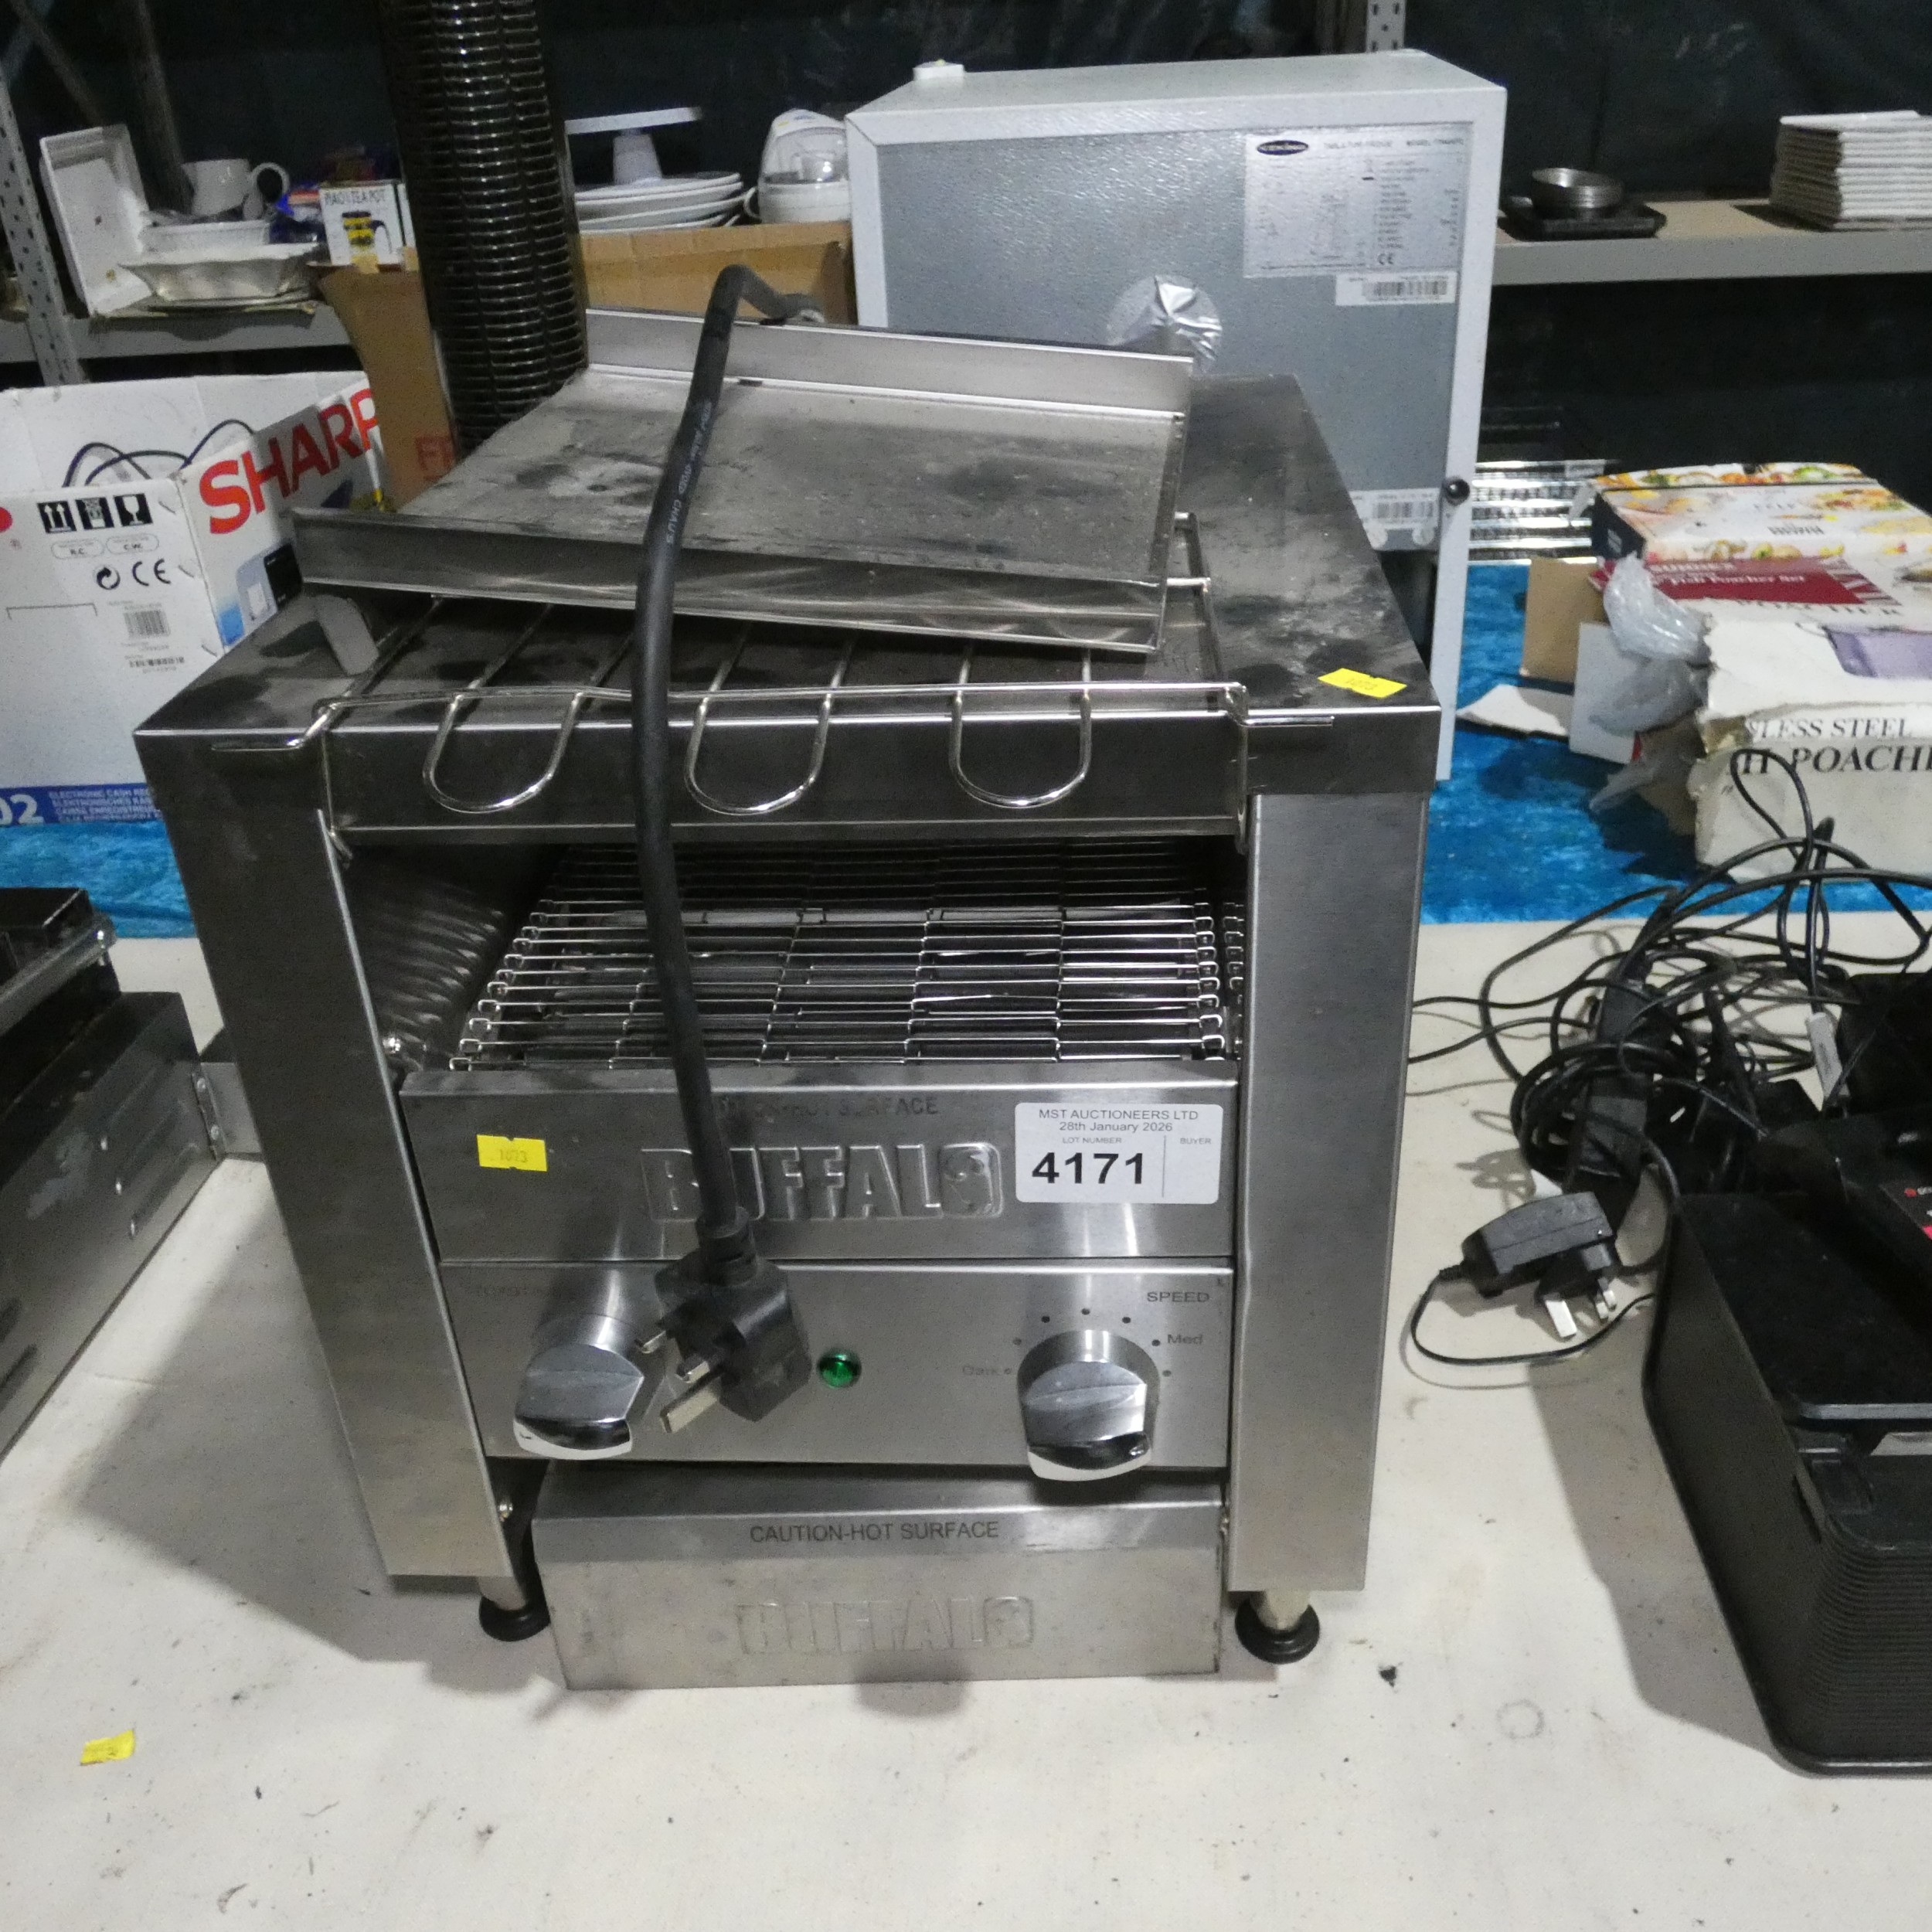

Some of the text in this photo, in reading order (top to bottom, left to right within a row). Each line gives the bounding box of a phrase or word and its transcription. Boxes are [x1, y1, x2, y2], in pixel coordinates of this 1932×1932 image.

[199, 387, 379, 535] SHARP
[1831, 717, 1913, 737] STEEL
[1039, 1109, 1199, 1120] MST AUCTIONEERS LTD
[1060, 1121, 1172, 1133] 28th January 2026
[1032, 1151, 1143, 1184] 4171
[1147, 1291, 1210, 1303] SPEED
[1167, 1333, 1203, 1345] Med
[750, 1521, 999, 1543] CAUTION-HOT SURFACE
